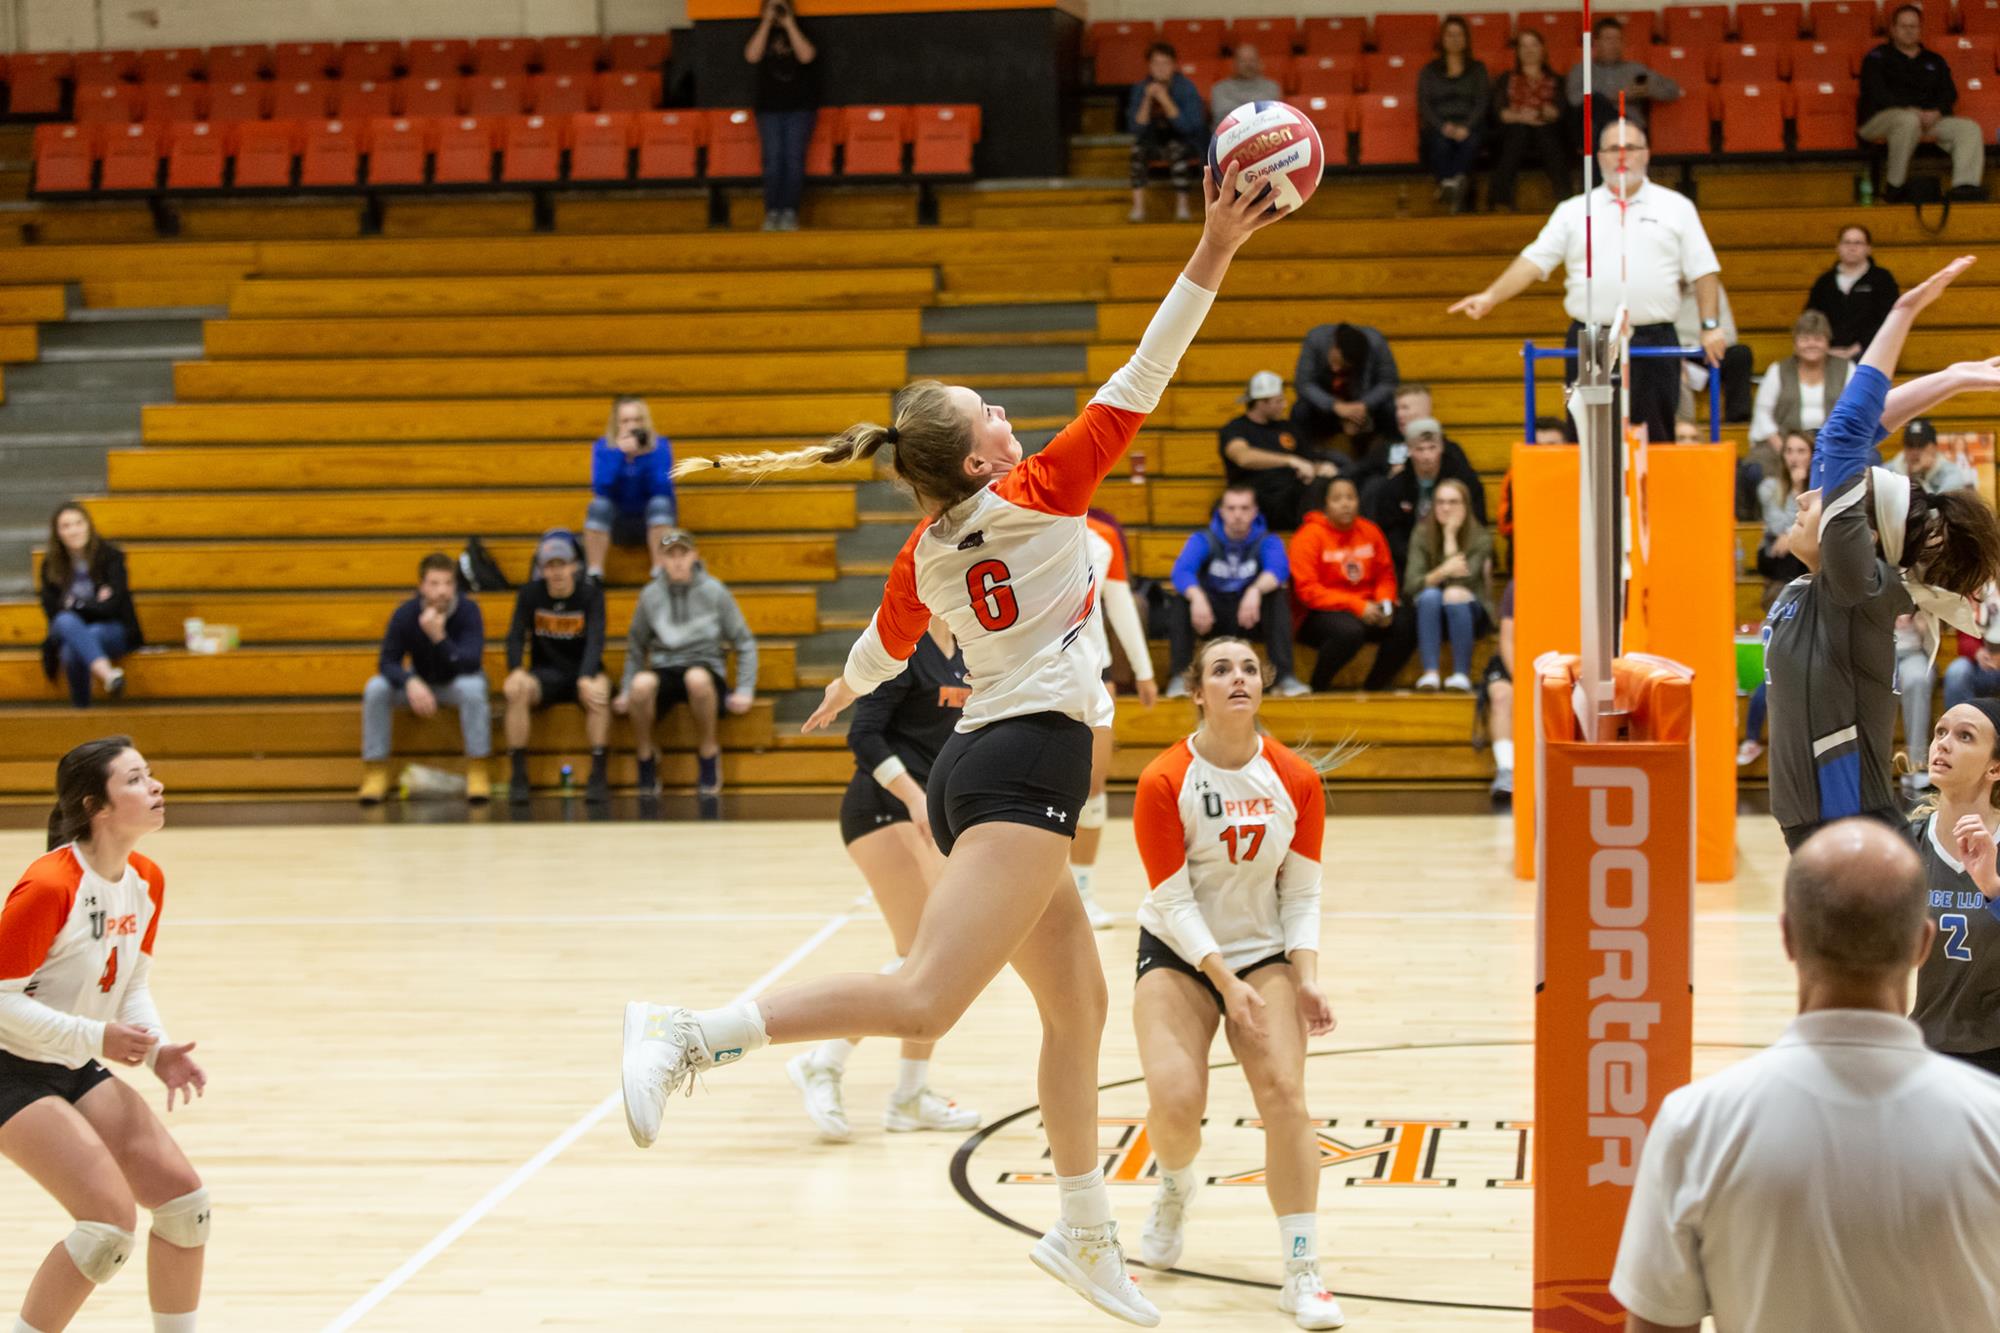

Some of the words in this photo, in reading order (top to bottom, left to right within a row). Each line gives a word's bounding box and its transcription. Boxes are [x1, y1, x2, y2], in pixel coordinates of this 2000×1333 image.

[1232, 126, 1294, 161] molten
[966, 559, 1019, 632] 6
[1219, 824, 1266, 865] 17
[1956, 892, 1988, 910] LLO
[1940, 913, 1972, 961] 2
[97, 946, 118, 993] 4
